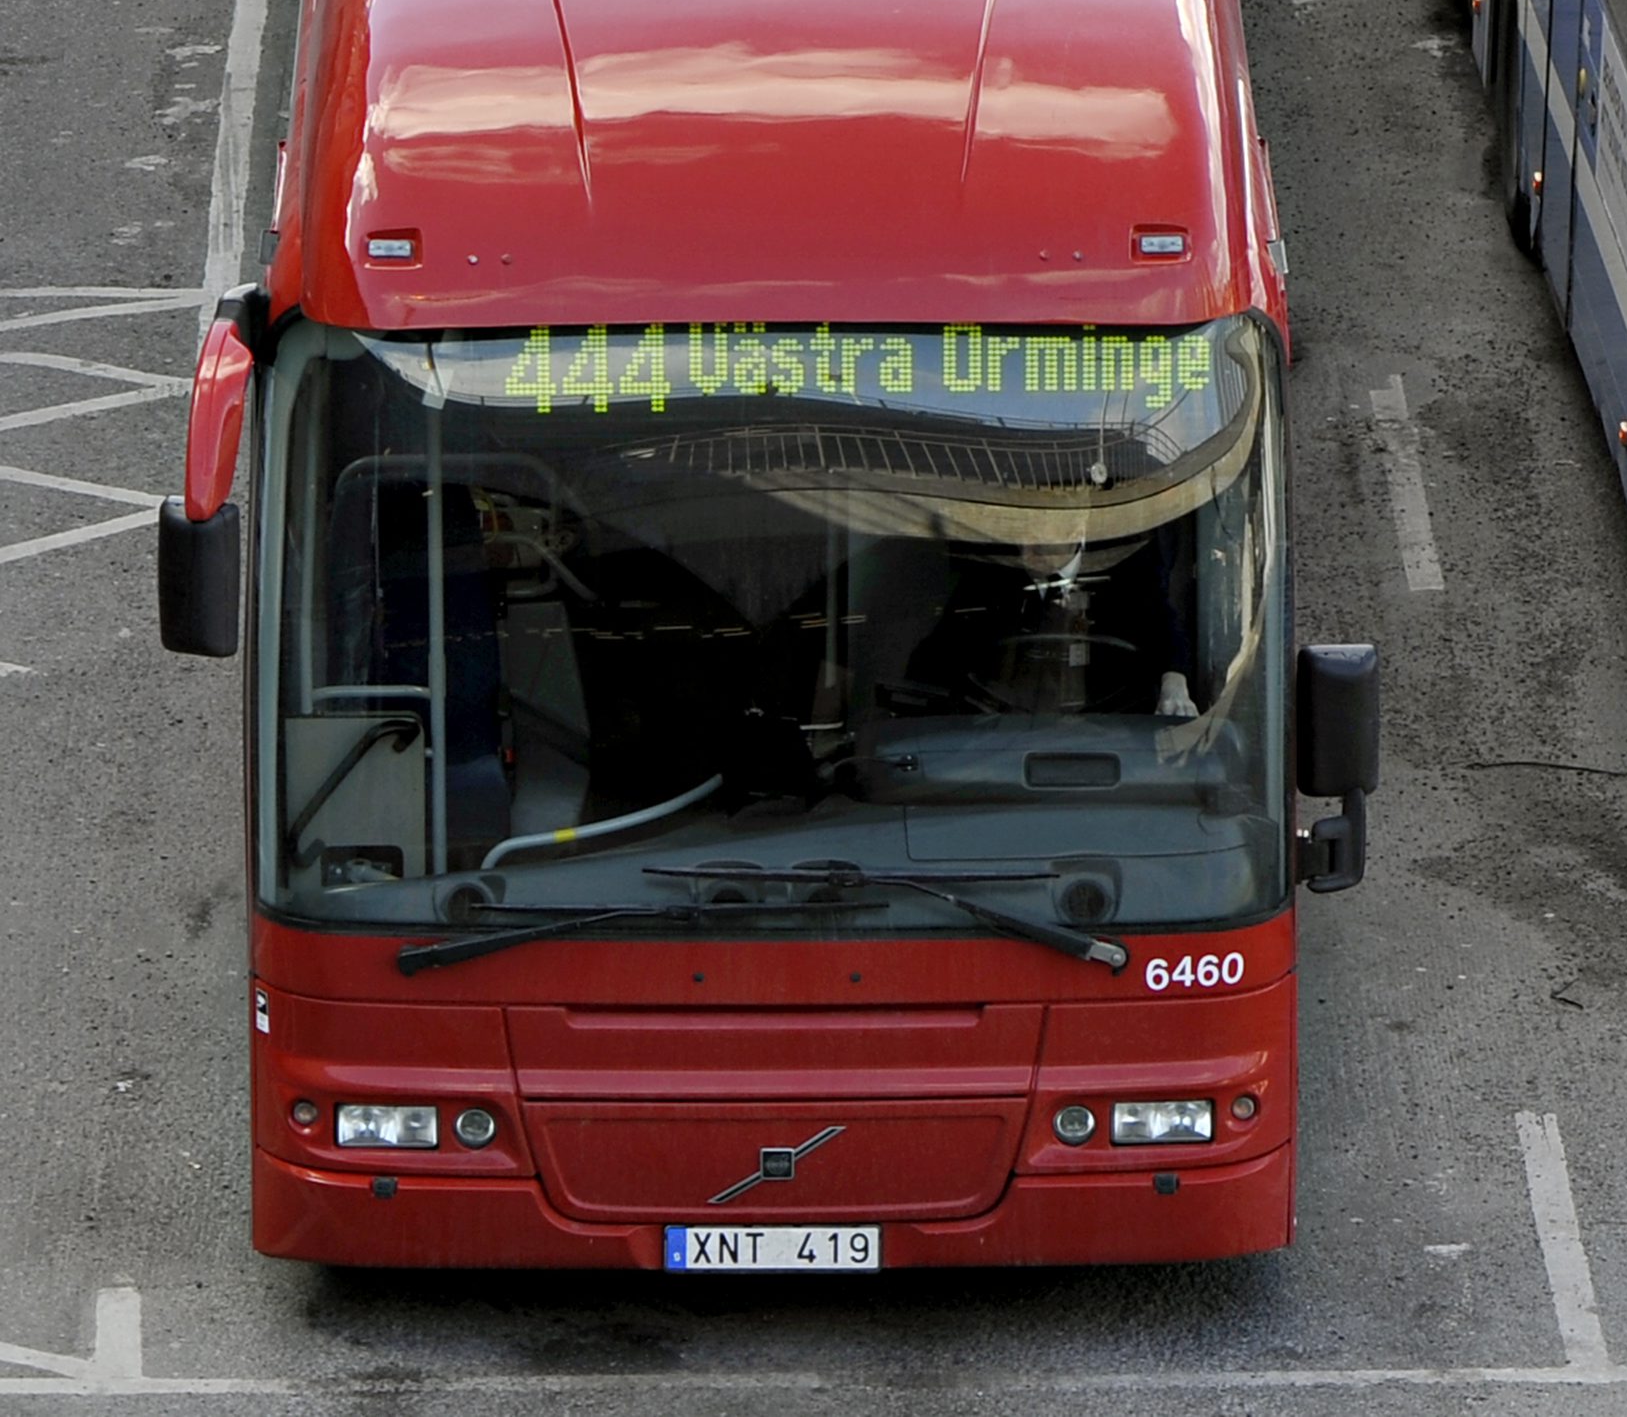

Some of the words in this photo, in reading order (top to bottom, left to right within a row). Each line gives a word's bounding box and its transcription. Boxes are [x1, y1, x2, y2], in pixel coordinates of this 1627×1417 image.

[505, 324, 671, 412] 444
[687, 322, 913, 394] Västra
[942, 323, 1210, 408] Orminge
[1144, 952, 1245, 992] 6460
[693, 1232, 764, 1264] XNT
[797, 1232, 869, 1264] 419
